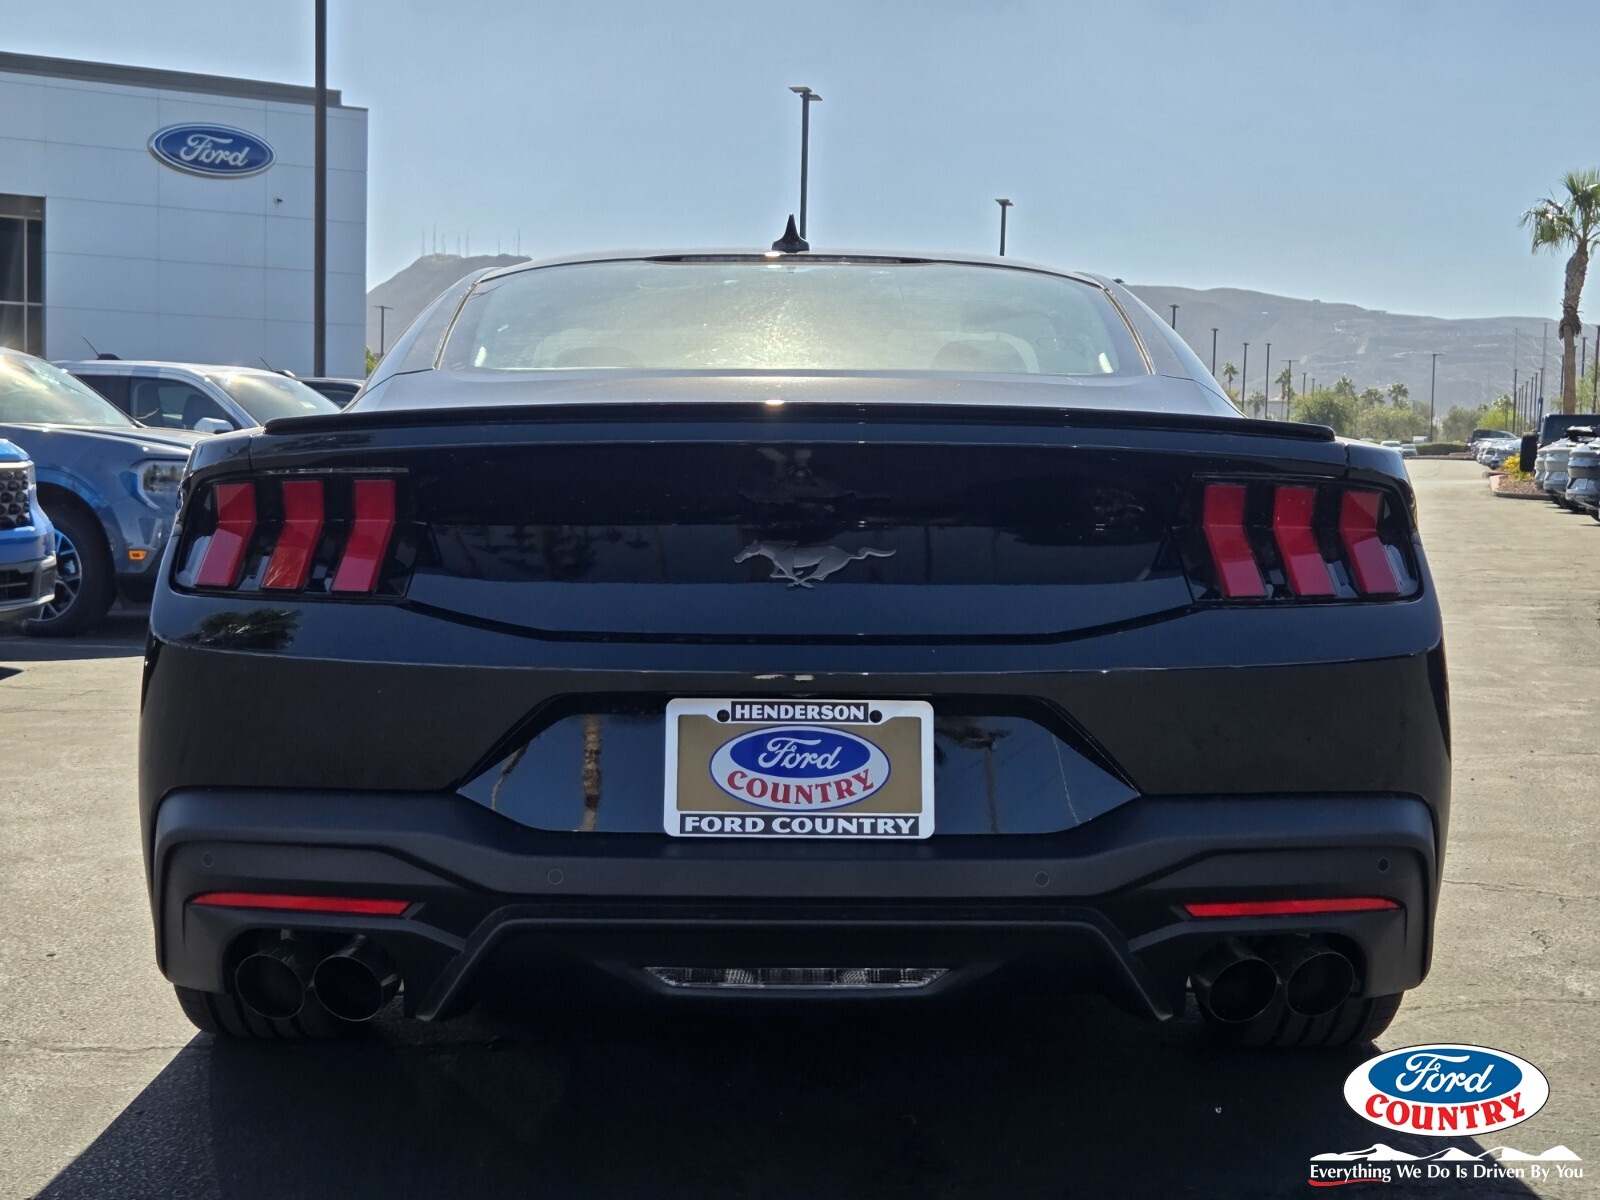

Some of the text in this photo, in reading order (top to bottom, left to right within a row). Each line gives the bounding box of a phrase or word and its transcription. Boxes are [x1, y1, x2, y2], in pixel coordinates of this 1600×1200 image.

[180, 134, 250, 167] Ford
[735, 705, 865, 720] HENDERSON
[758, 737, 842, 769] Ford
[727, 769, 874, 805] COUNTRY
[685, 816, 916, 834] FORD COUNTRY
